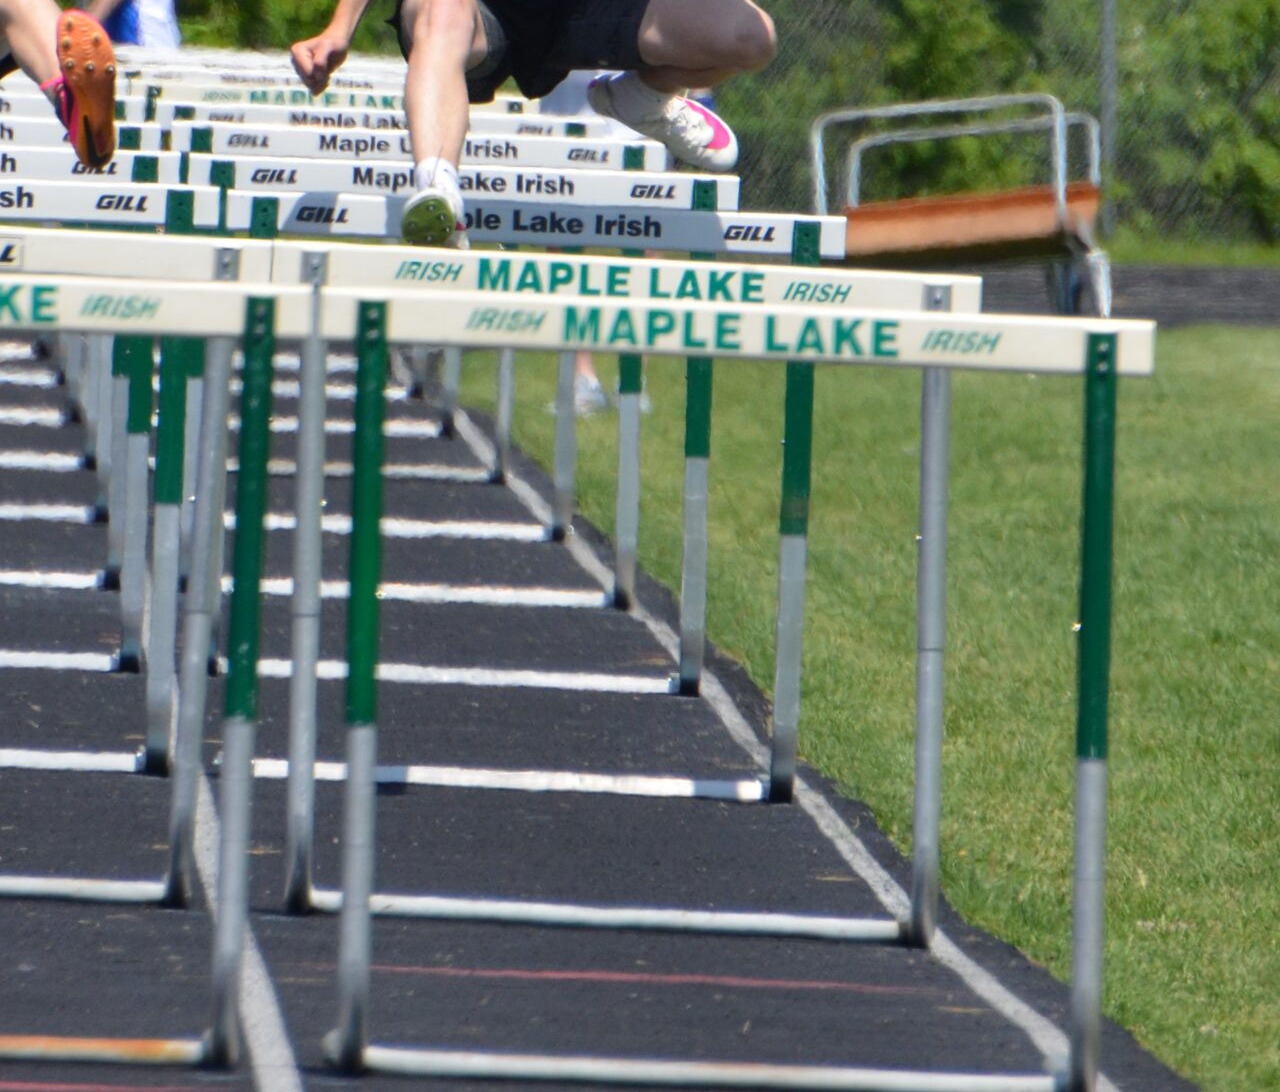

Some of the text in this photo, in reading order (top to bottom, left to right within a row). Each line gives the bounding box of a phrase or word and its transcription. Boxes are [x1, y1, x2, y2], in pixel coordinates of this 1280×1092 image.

[363, 115, 410, 130] Lak
[319, 134, 390, 154] Maple
[465, 140, 517, 159] Irish
[567, 147, 610, 163] GILL
[251, 169, 298, 185] GILL
[353, 166, 575, 196] Mapl ake Irish
[630, 184, 676, 200] GILL
[95, 194, 149, 212] GILL
[295, 205, 350, 224] GILL
[512, 210, 584, 235] Lake
[594, 213, 662, 238] Irish
[723, 225, 776, 243] GILL
[394, 258, 852, 304] IRISH MAPLE LAKE IRISH
[79, 293, 161, 319] IRISH
[465, 305, 1003, 359] IRISH MAPLE LAKE IRISH
